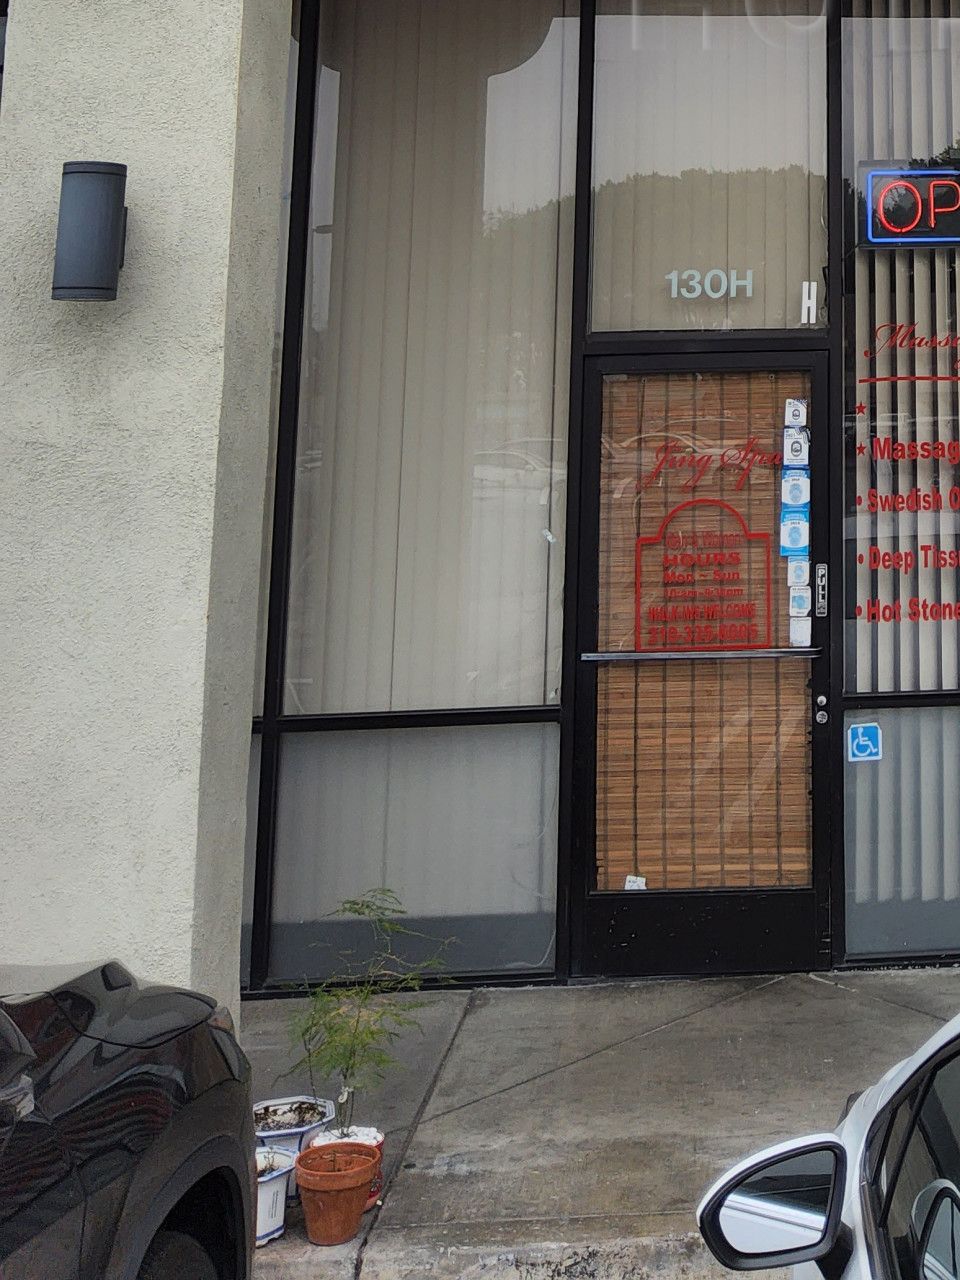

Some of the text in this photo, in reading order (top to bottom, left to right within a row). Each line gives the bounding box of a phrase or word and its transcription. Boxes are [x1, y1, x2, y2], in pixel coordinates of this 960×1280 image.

[664, 268, 753, 299] 130H
[801, 281, 818, 324] H
[636, 436, 783, 493] Jing Spa
[867, 486, 943, 513] Swedish
[663, 552, 741, 568] HOURS
[713, 569, 740, 581] Sun
[868, 545, 914, 575] Deep
[817, 568, 826, 603] PULL
[866, 598, 901, 623] Hot
